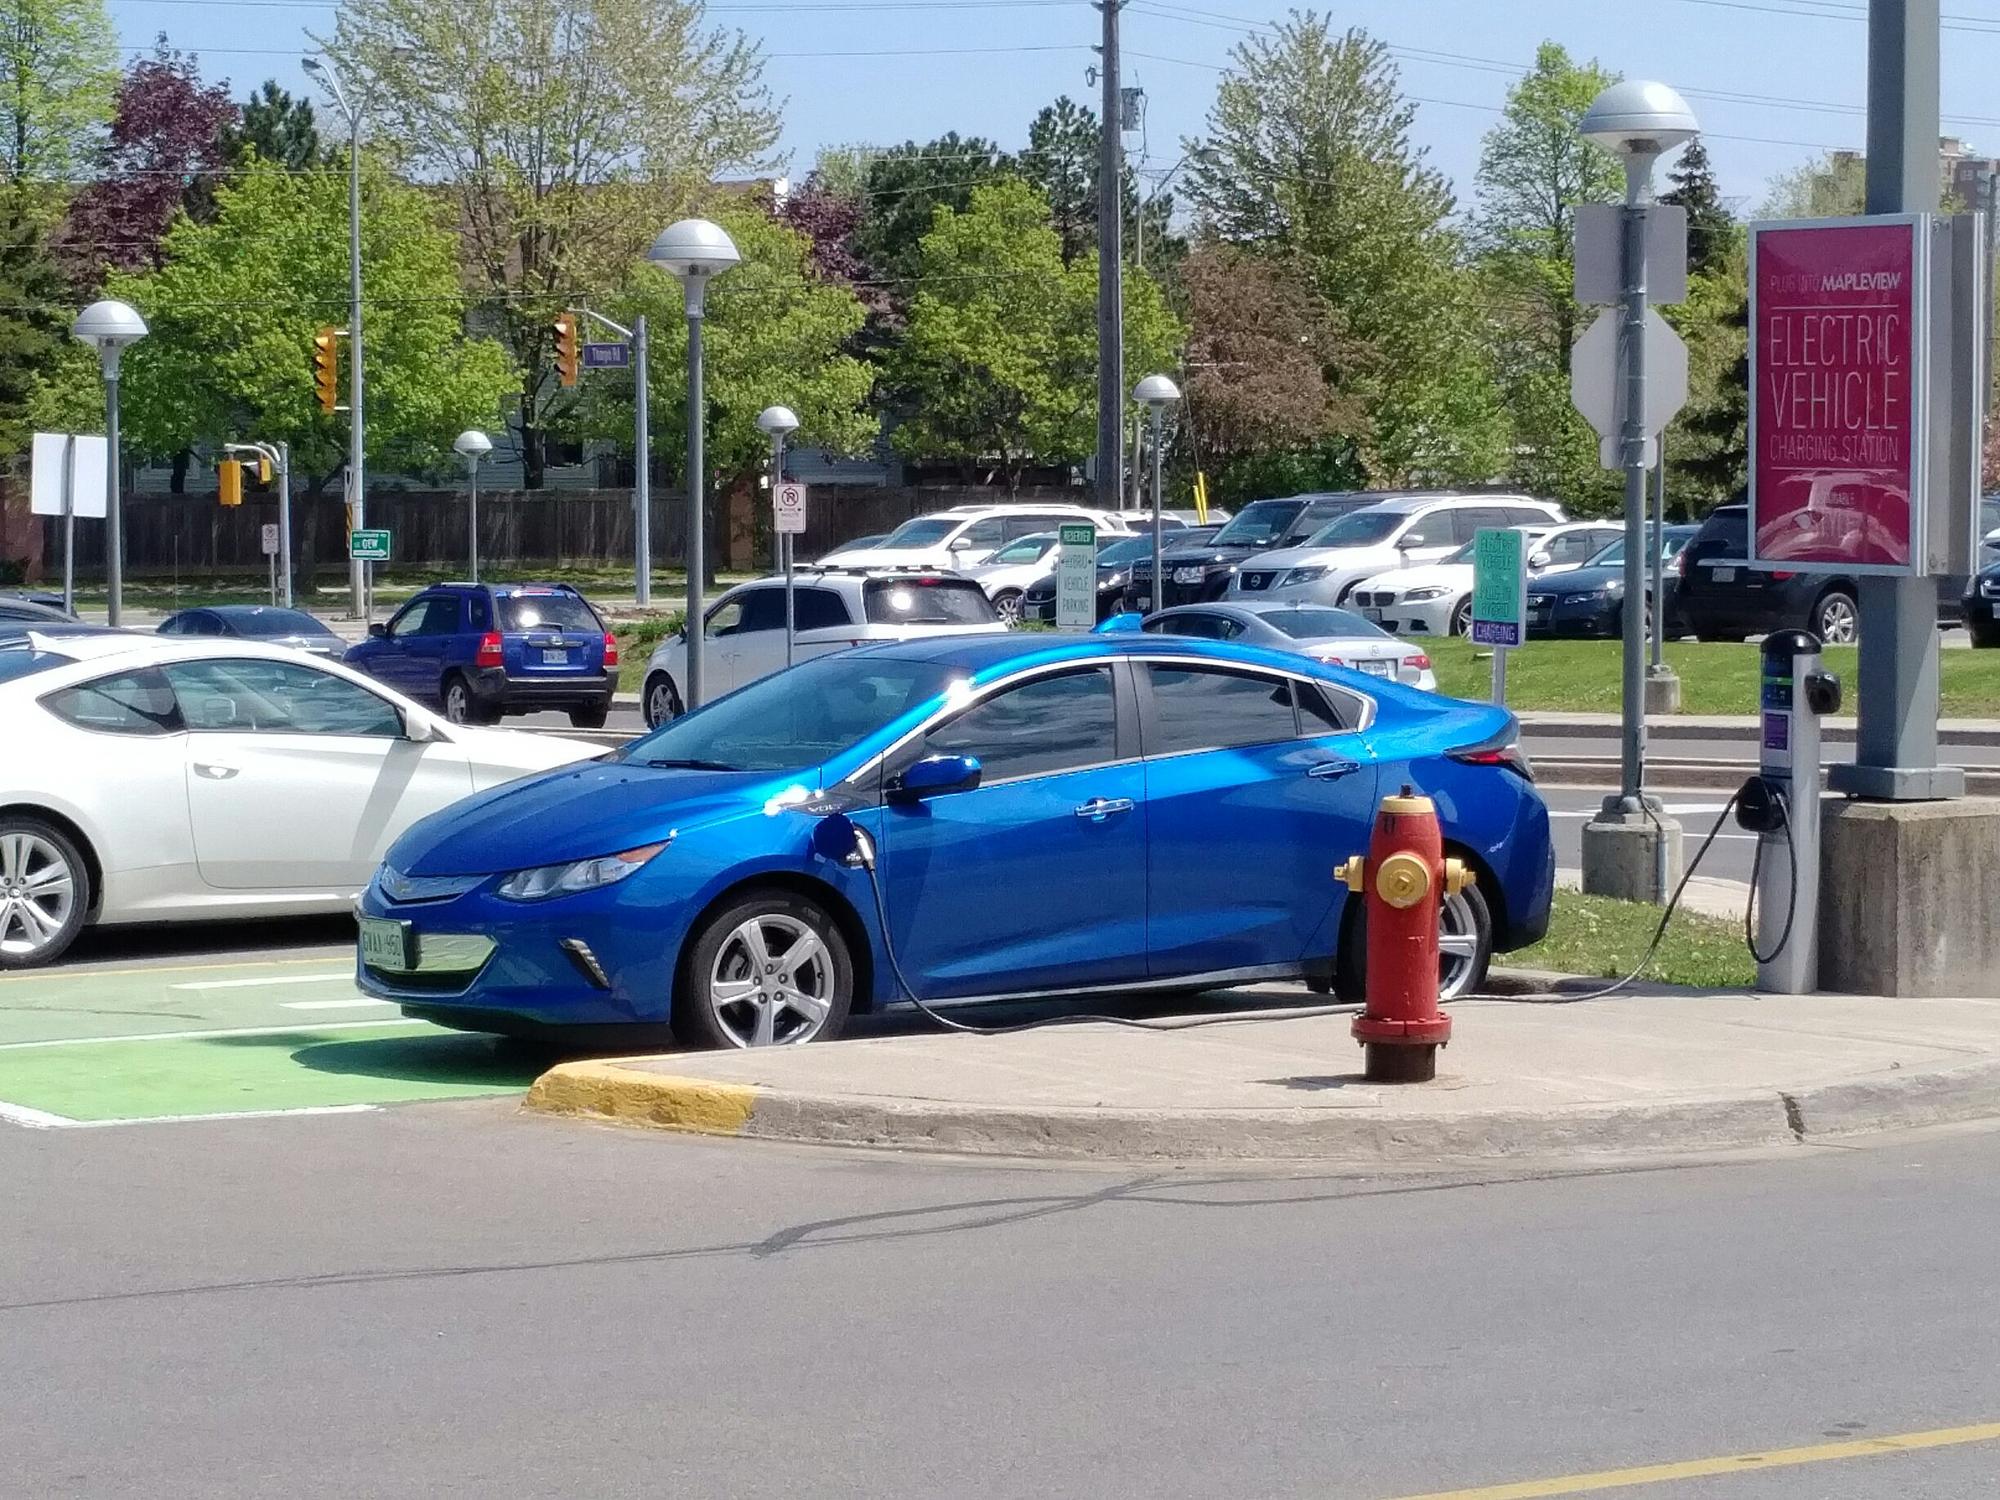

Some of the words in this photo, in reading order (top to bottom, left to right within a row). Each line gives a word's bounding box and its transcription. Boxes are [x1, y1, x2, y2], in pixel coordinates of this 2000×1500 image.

[1820, 272, 1902, 291] MAPLEVIEW
[1770, 315, 1899, 366] ELECTRIC
[1770, 372, 1899, 430] VEHICLE
[1770, 433, 1837, 462] CHARGING
[1841, 434, 1899, 463] STATION
[1063, 530, 1091, 542] RESERVED
[1063, 576, 1090, 591] VEHICLE
[1062, 598, 1089, 612] PARKING
[1476, 622, 1516, 641] CHARGING
